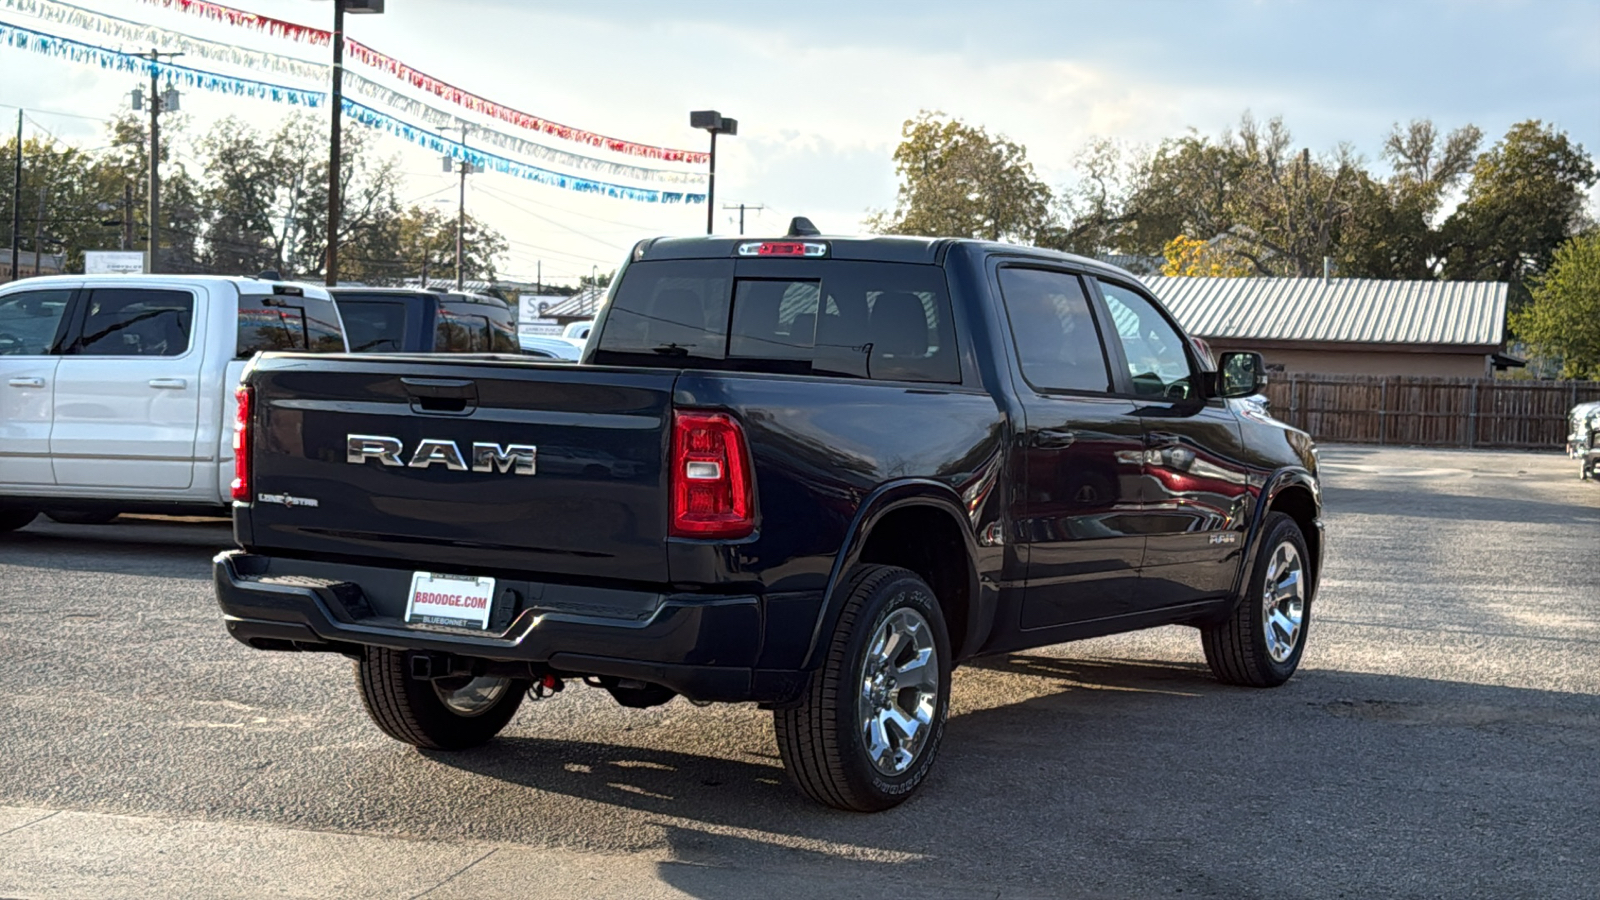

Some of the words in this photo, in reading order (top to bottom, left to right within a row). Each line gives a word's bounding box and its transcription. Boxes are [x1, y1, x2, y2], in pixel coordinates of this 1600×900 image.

[347, 434, 537, 476] RAM
[415, 591, 487, 609] BBDODGE.COM
[422, 616, 468, 627] BLUEBONNET
